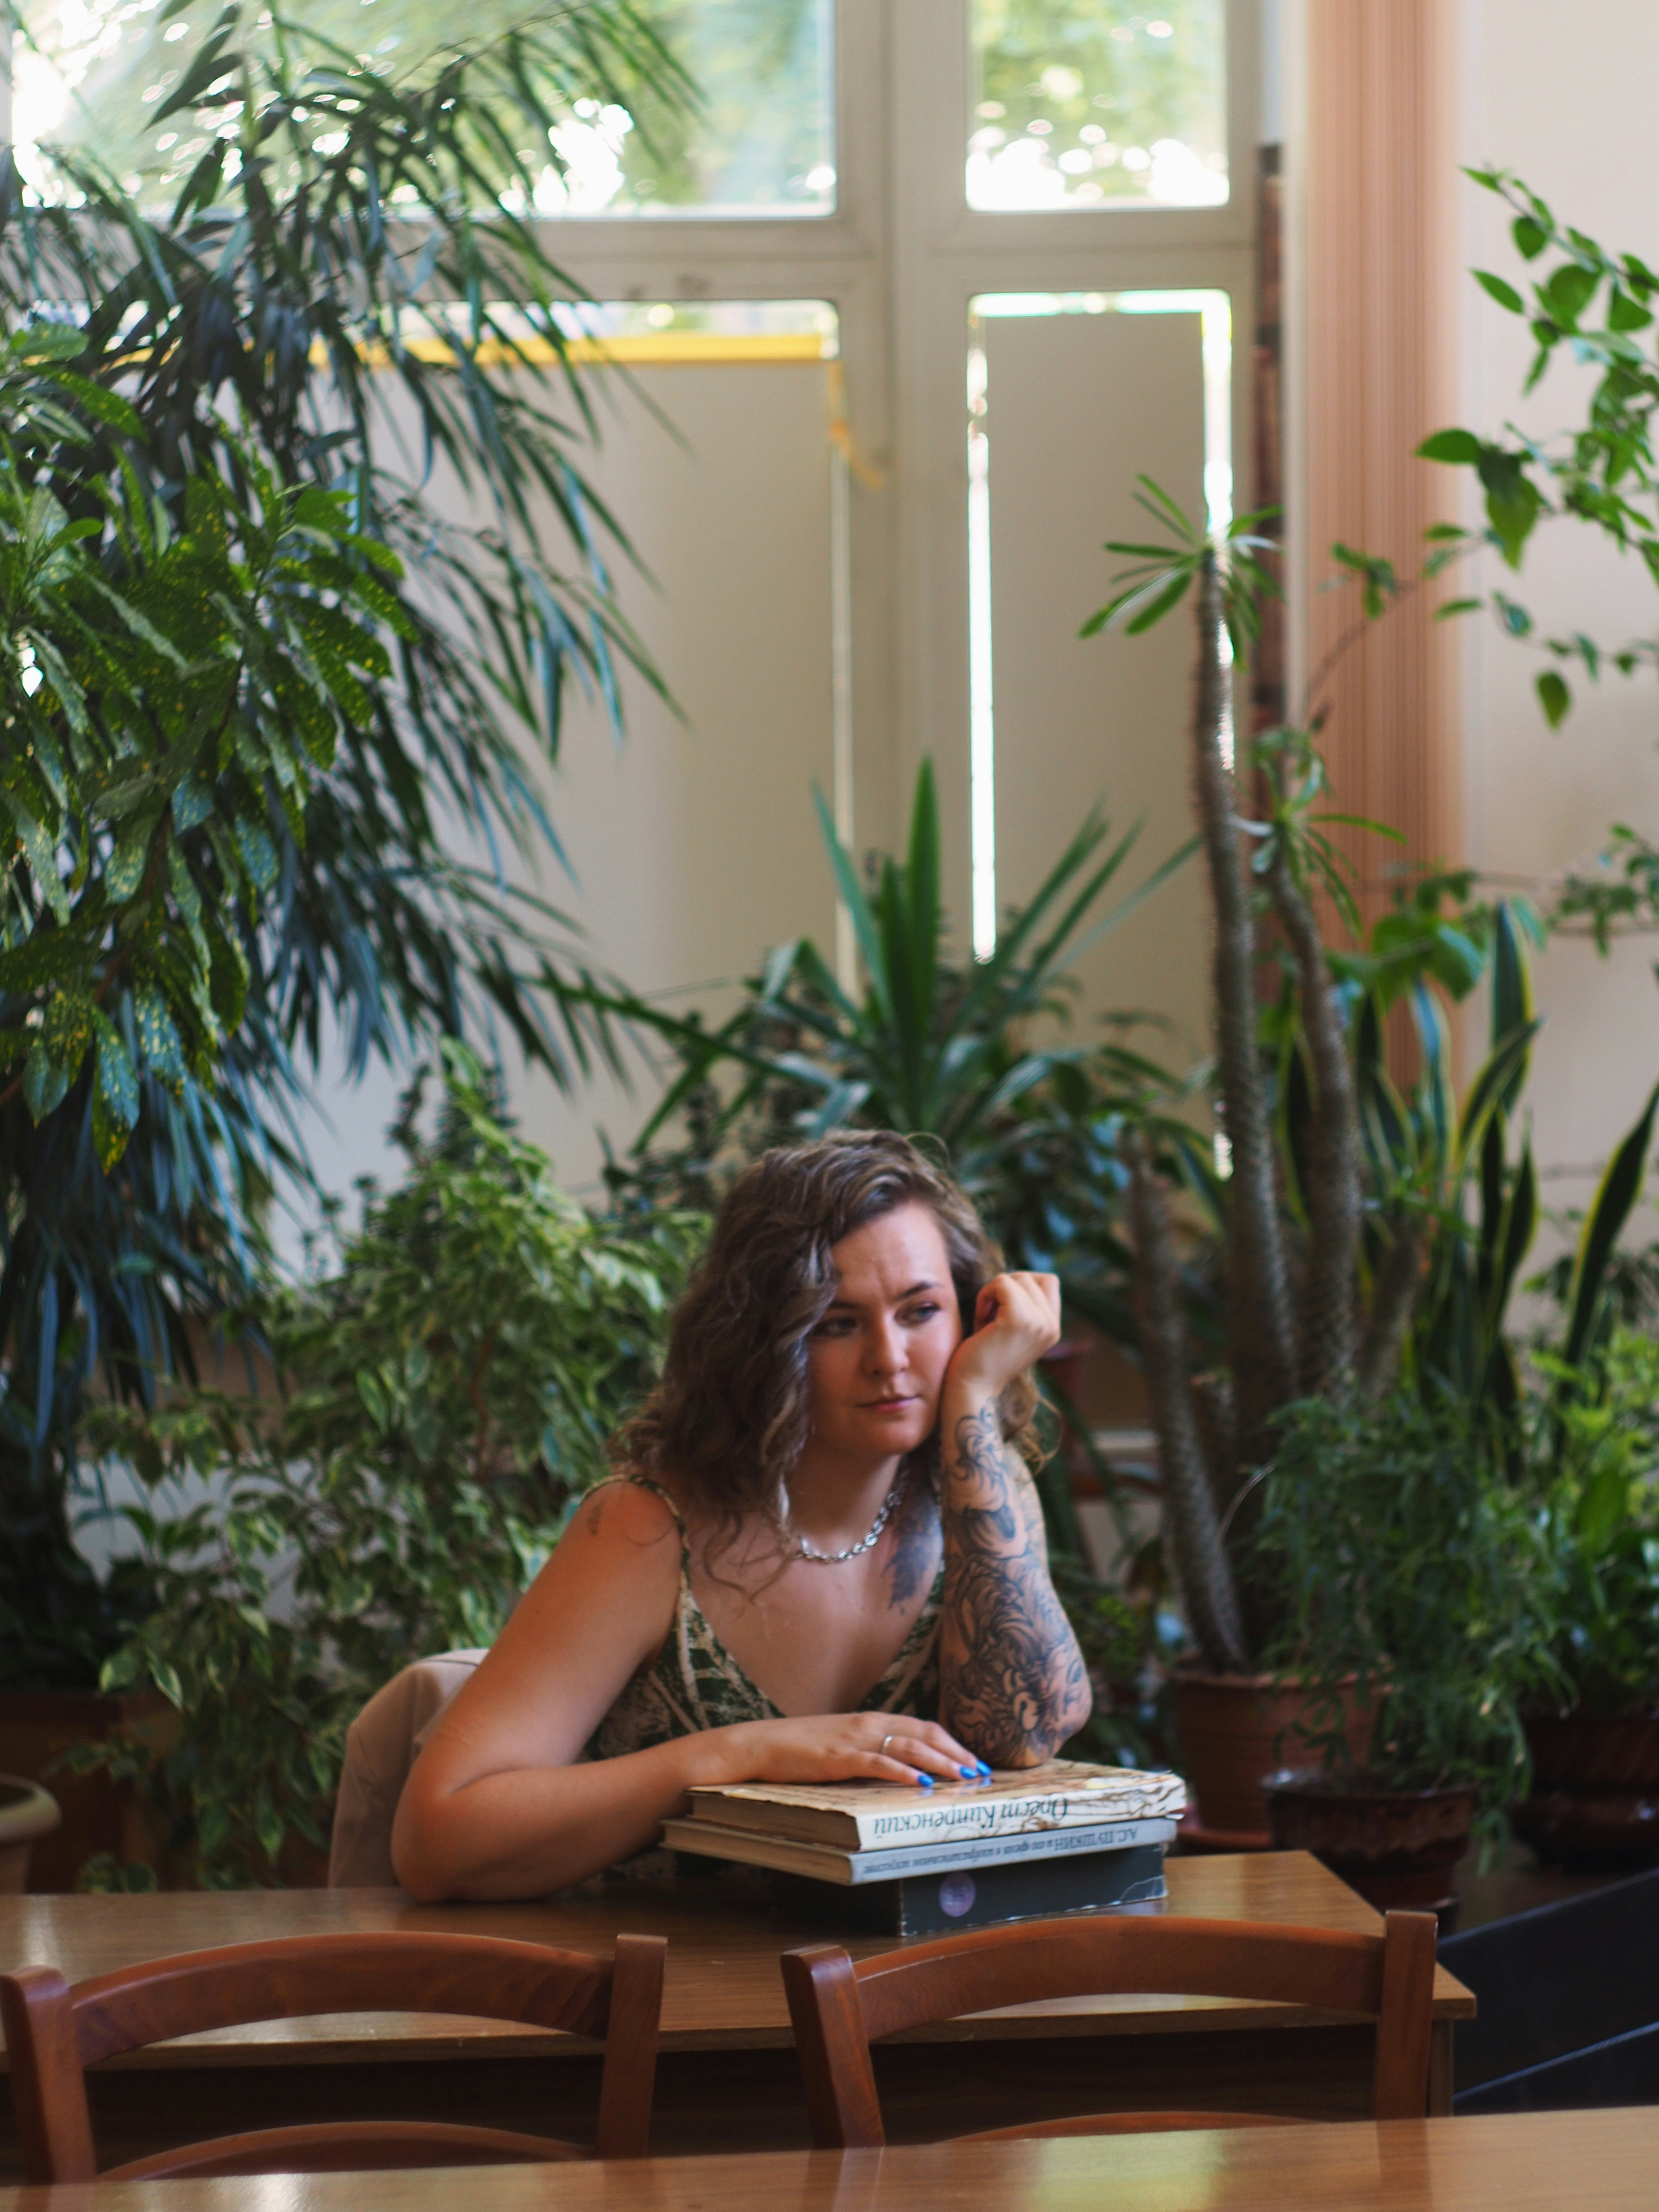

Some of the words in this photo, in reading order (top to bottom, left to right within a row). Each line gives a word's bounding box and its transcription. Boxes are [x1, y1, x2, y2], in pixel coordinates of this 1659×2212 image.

[1001, 1796, 1068, 1821] Орест
[874, 1804, 996, 1839] Кипренский
[1055, 1830, 1114, 1851] ПУШКИН
